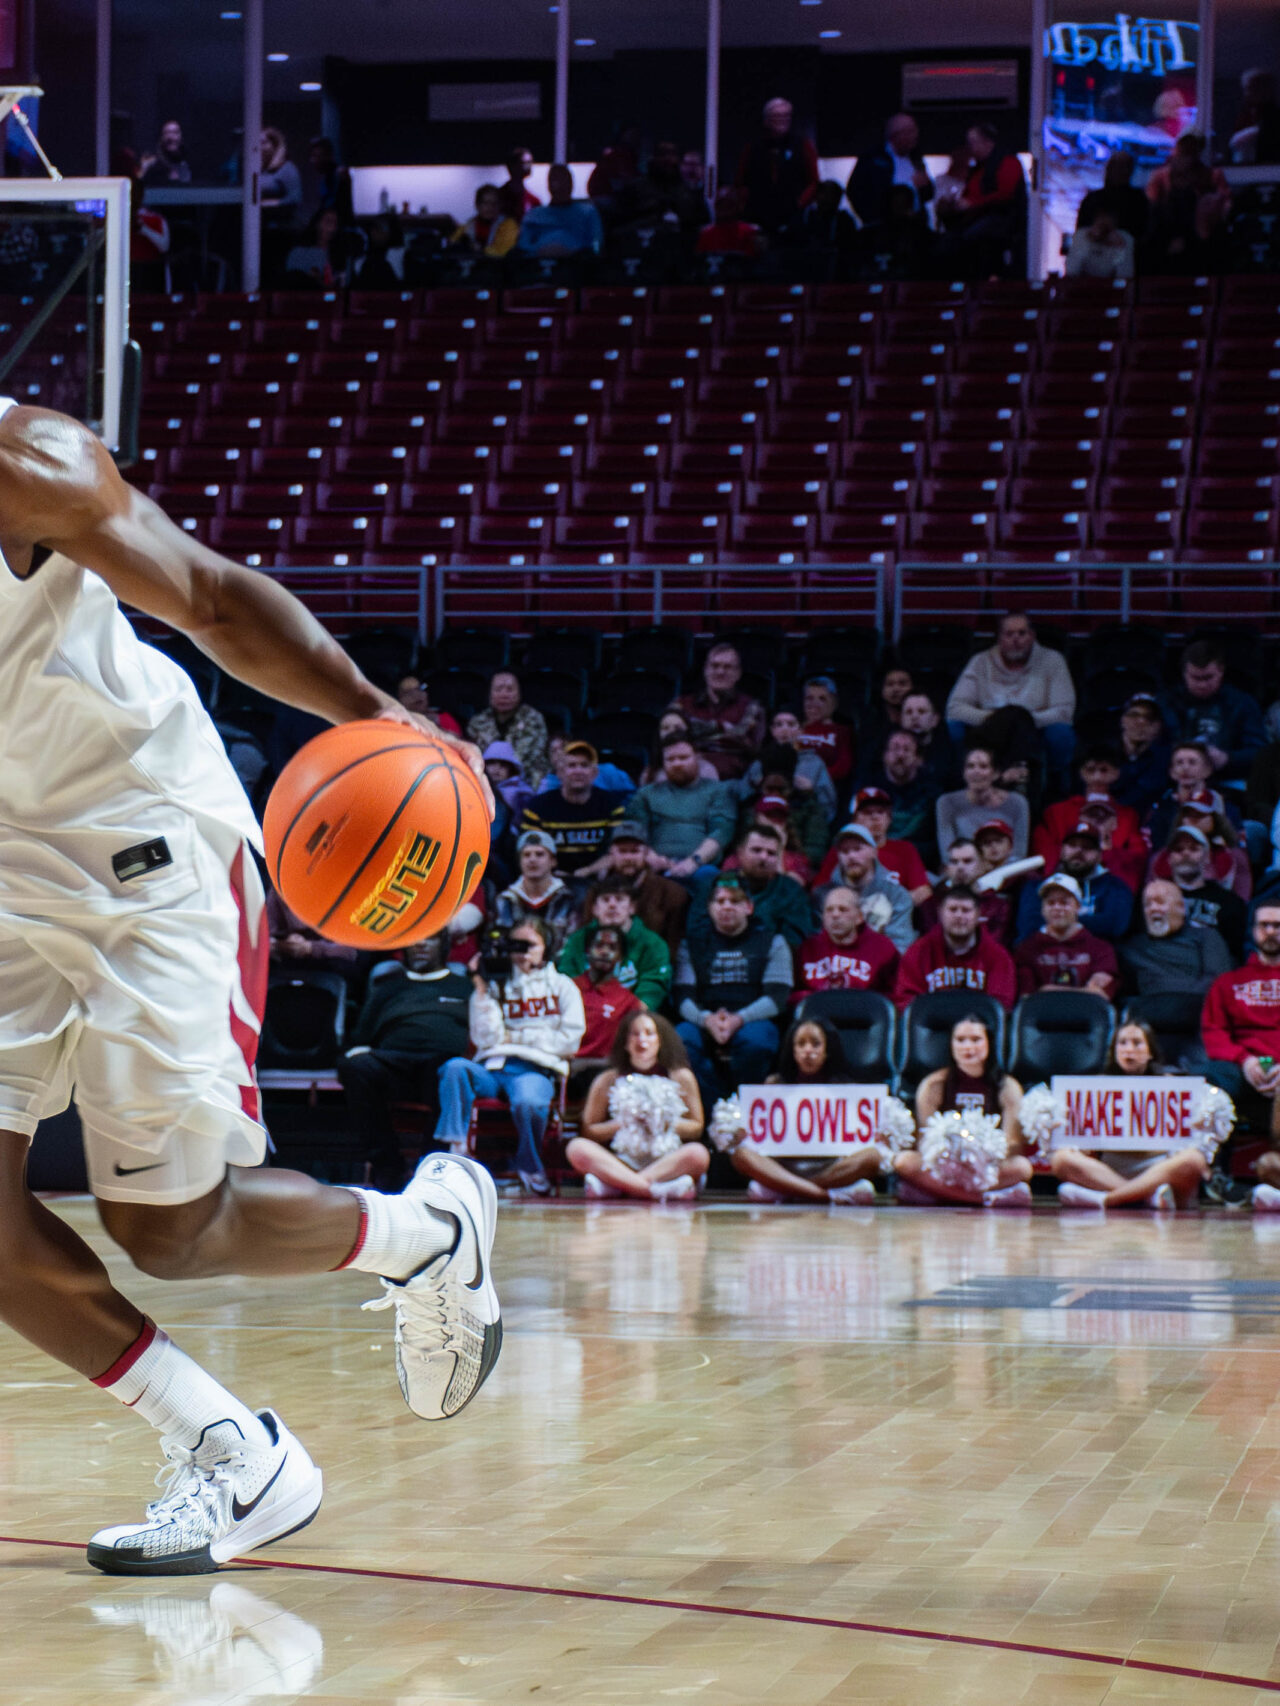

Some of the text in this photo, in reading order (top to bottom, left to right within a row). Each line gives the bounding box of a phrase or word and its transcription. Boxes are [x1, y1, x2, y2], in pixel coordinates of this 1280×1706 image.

[358, 830, 442, 934] ELITE
[804, 954, 872, 981] TEMPLE
[503, 995, 561, 1019] EMPLE
[750, 1098, 880, 1143] GO OWLS!
[1065, 1090, 1192, 1138] MAKE NOISE
